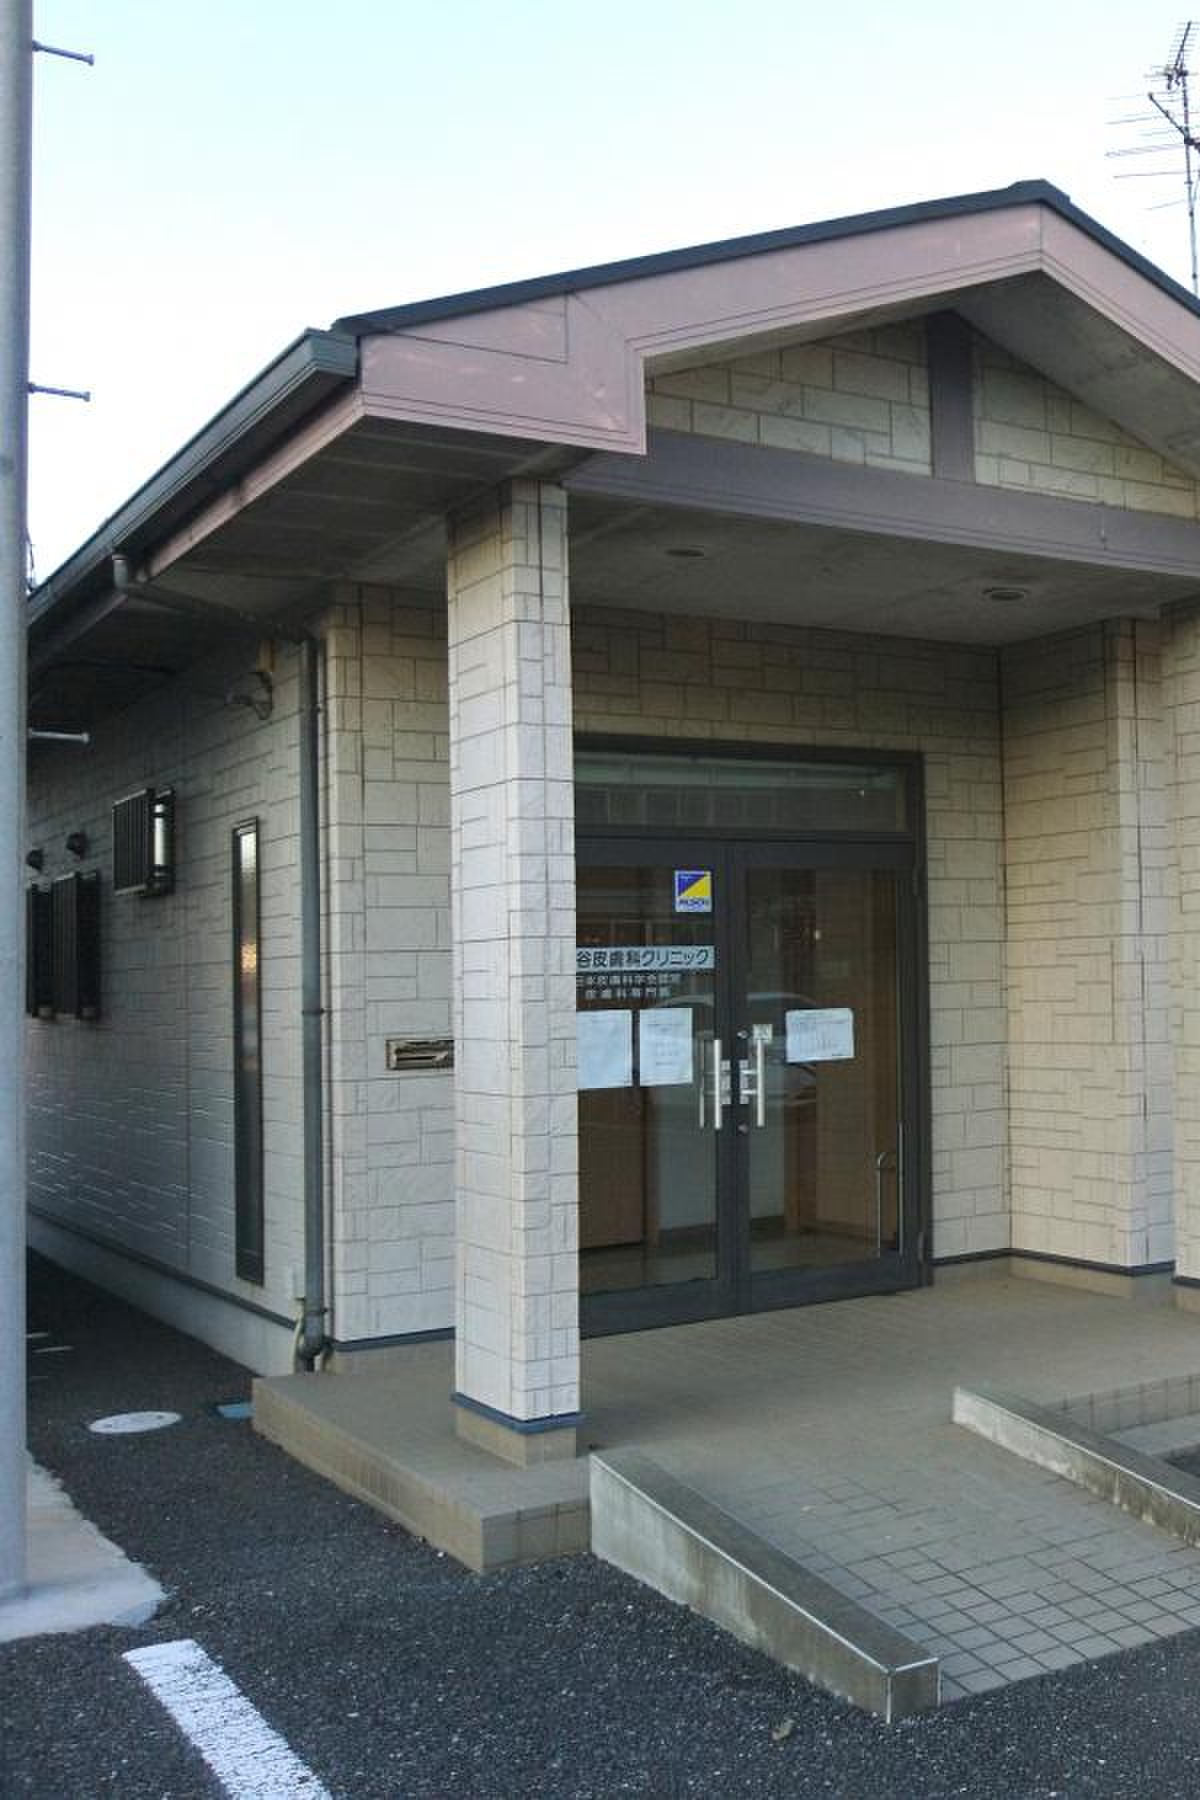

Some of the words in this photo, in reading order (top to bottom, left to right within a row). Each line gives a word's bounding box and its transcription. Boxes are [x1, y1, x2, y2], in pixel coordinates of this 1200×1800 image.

[576, 949, 709, 968] 谷皮膚科クリニック
